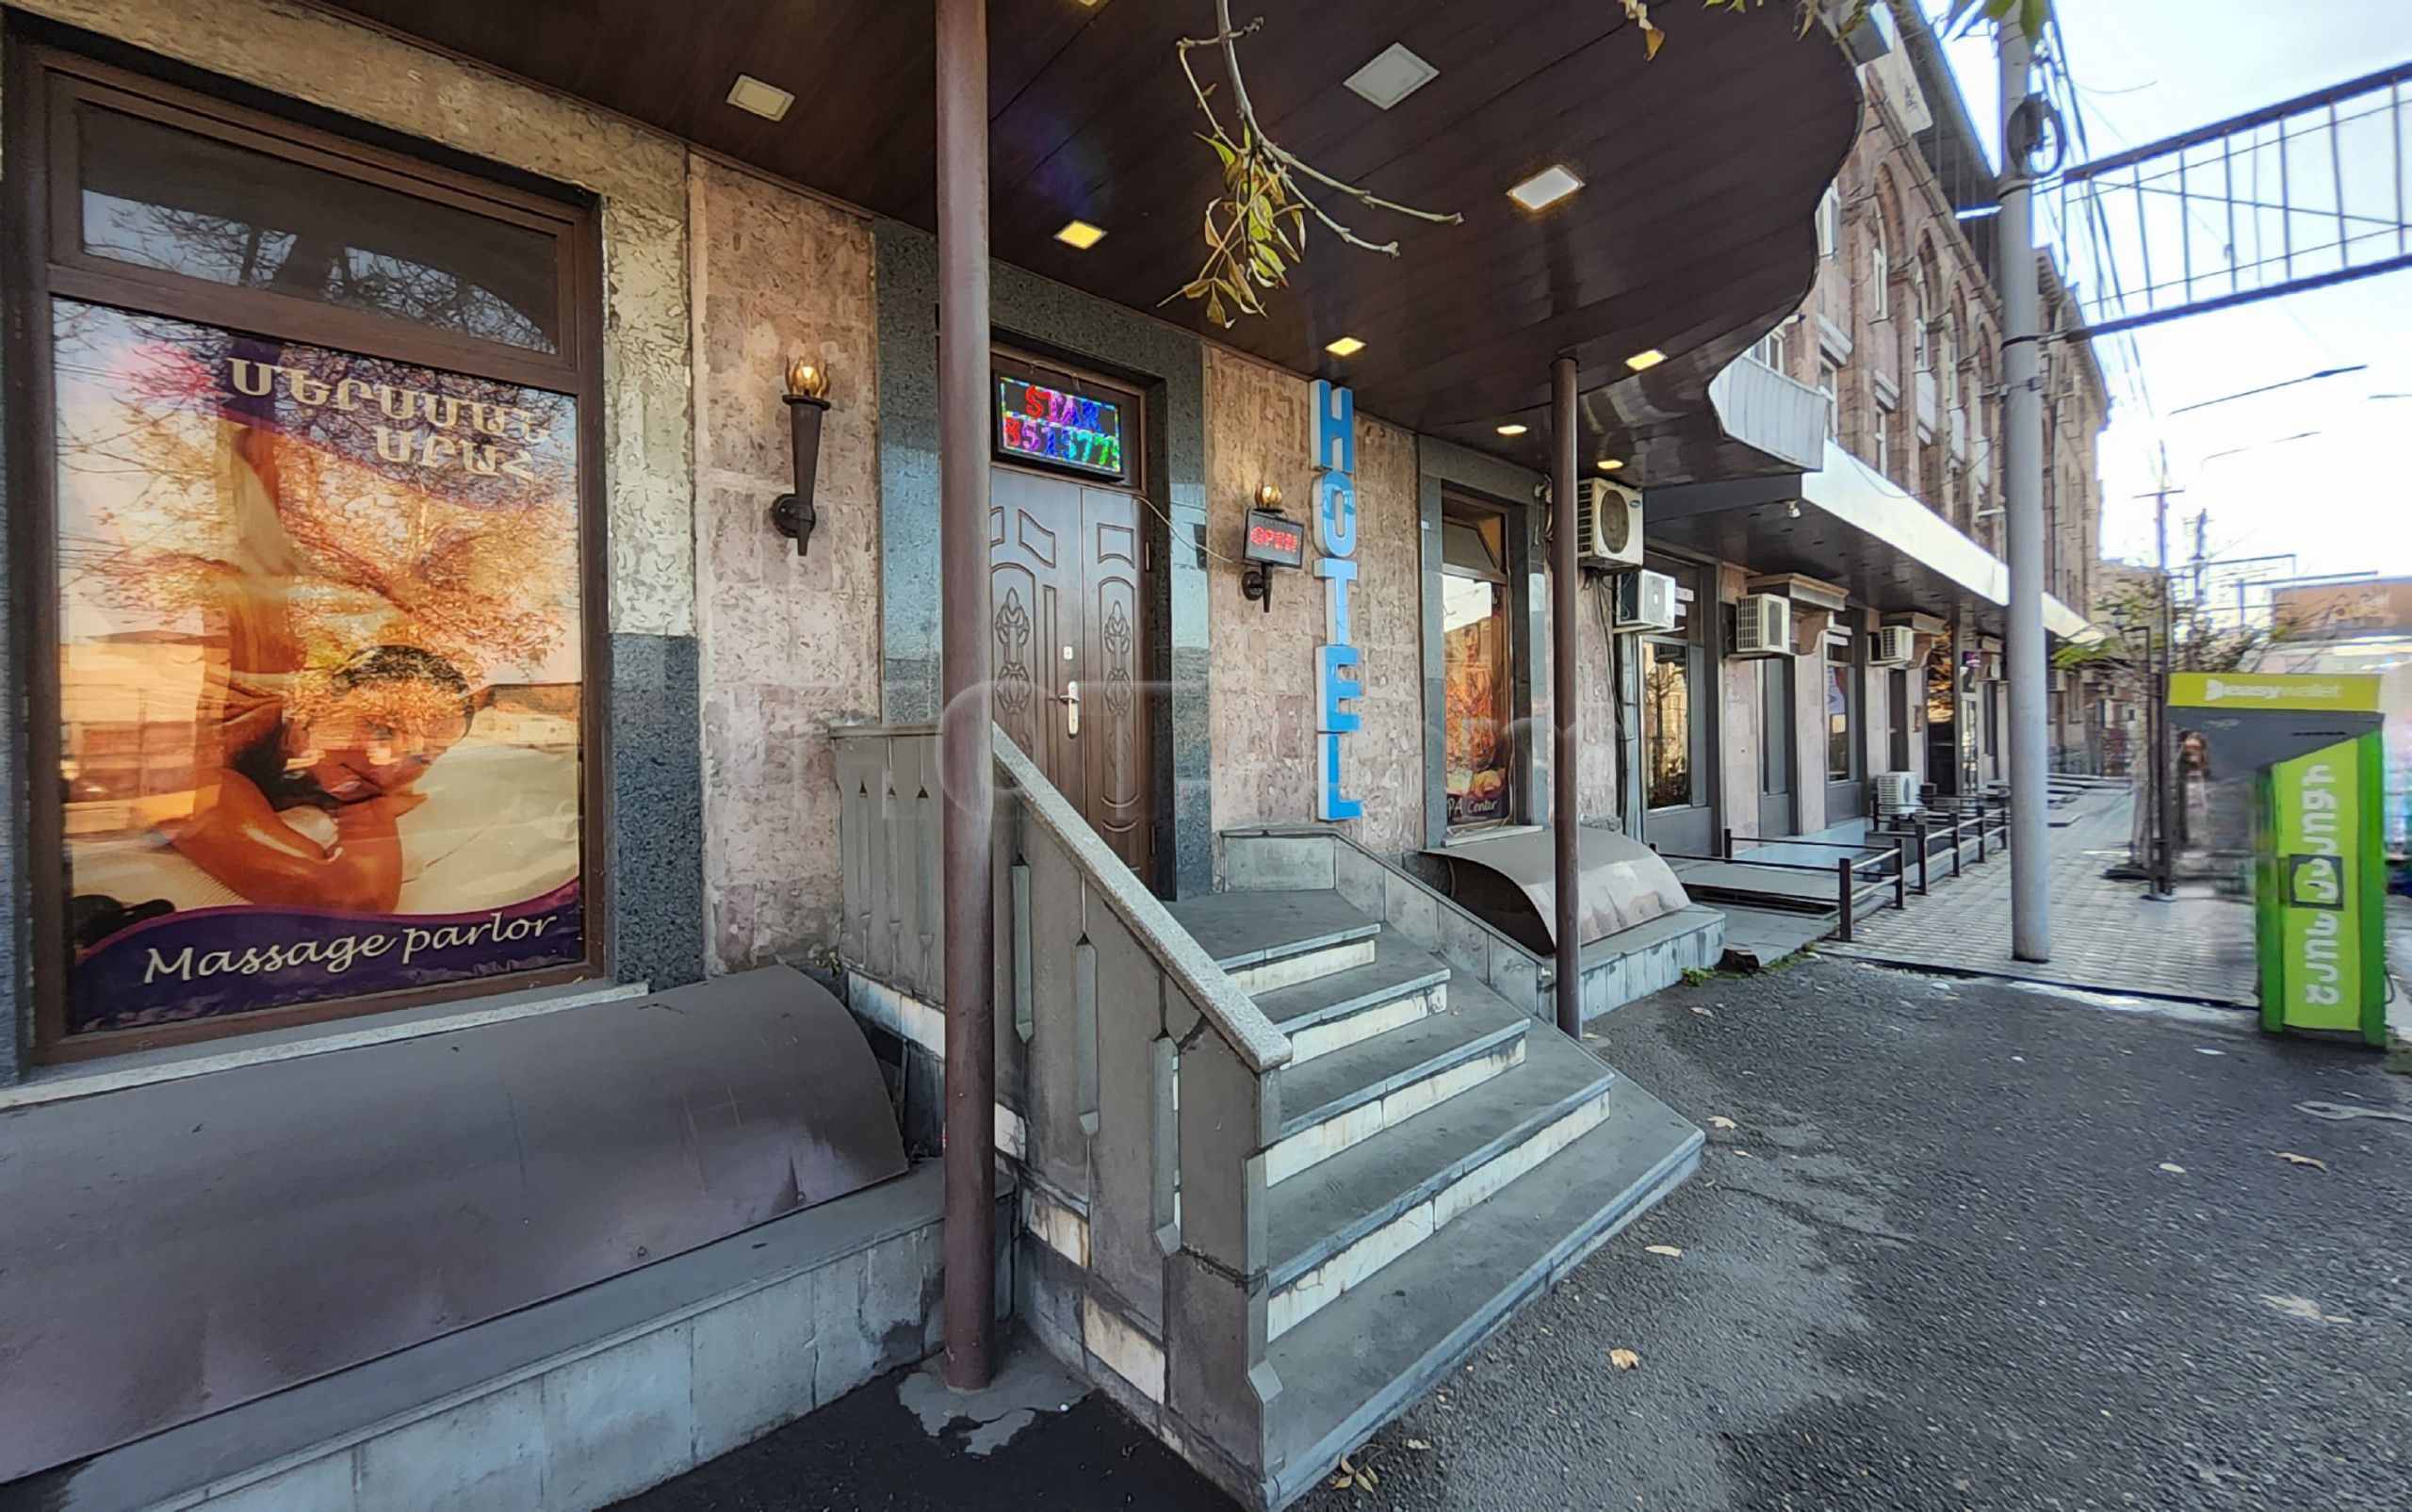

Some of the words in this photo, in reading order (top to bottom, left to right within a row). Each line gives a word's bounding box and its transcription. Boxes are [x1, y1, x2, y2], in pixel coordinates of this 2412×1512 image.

[1025, 384, 1104, 434] STAR
[1250, 526, 1298, 553] OPEN
[1311, 379, 1362, 821] HOTEL
[143, 931, 398, 984] Massage
[402, 913, 558, 964] parlor
